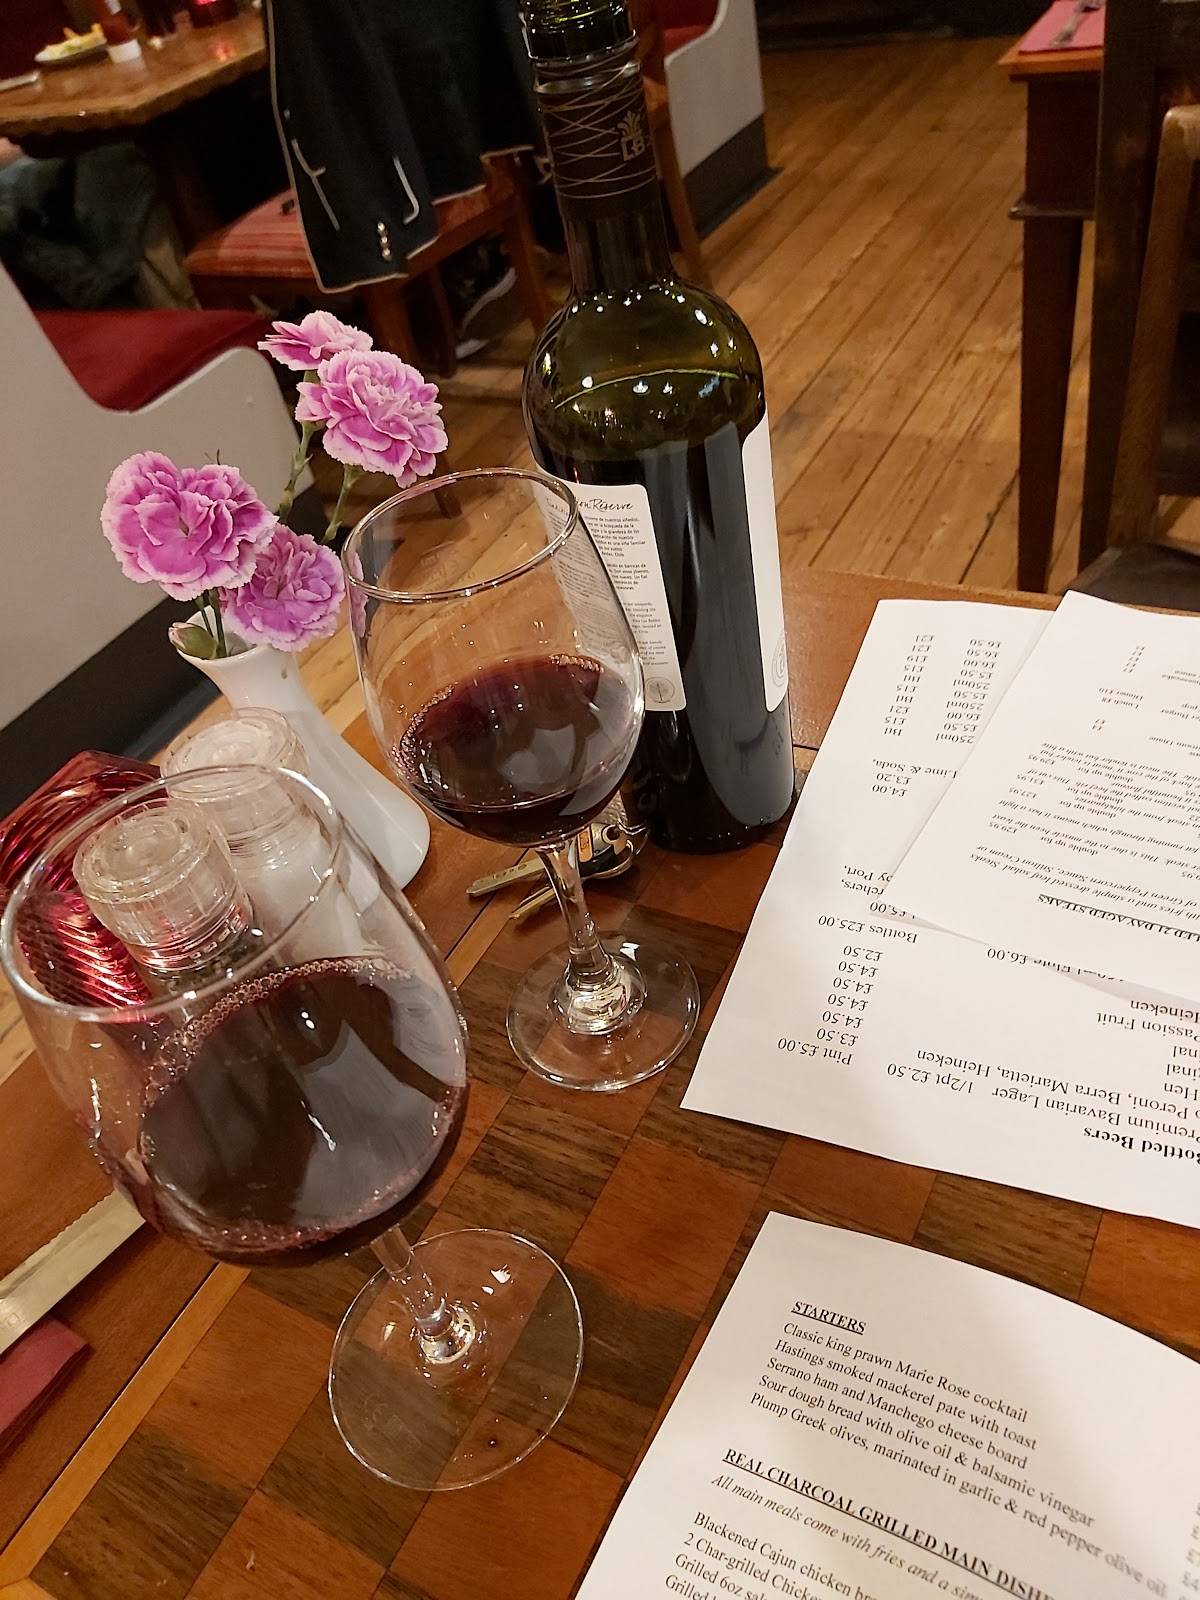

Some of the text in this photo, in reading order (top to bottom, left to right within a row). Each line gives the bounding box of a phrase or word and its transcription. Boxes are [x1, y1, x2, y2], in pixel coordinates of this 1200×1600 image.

[963, 659, 997, 669] £6.00
[960, 669, 993, 680] £5.50
[896, 684, 988, 700] £5.50 £15
[952, 679, 991, 691] 250ml
[889, 704, 982, 721] £6.00 £21
[945, 700, 985, 711] 250ml
[884, 716, 979, 733] £5.50 £15
[935, 732, 976, 744] 250ml
[876, 773, 912, 786] £3.20
[909, 765, 922, 775] &
[924, 767, 958, 780] Lime
[871, 785, 908, 798] £4.00
[840, 878, 886, 900] rchers,
[1036, 893, 1088, 914] STEAKS
[1088, 906, 1128, 924] AGED
[1126, 915, 1156, 931] DAY
[818, 914, 918, 944] Bottles £25.00
[1158, 924, 1173, 935] 21
[843, 945, 884, 962] £2.50
[987, 947, 1029, 965] £6.00
[838, 960, 879, 978] £4.50
[832, 976, 875, 995] £4.50
[827, 993, 869, 1012] £4.50
[1096, 1012, 1136, 1031] Fruit
[777, 1037, 820, 1057] £5.00
[822, 1010, 1199, 1102] Hen £4.50
[823, 1047, 853, 1066] Pint
[816, 1027, 1189, 1120] Peroni, Berra Marietta, Heineken £3.50
[887, 1063, 932, 1084] £2.50
[935, 1072, 973, 1094] 1/2pt
[991, 1087, 1040, 1109] Lager
[1045, 1098, 1121, 1126] Bavarian
[1083, 1127, 1134, 1150] Beers
[790, 1300, 867, 1336] STARTERS
[783, 1322, 1028, 1423] Classic king prawn Marie Rose cocktail
[774, 1338, 1037, 1451] Hastings smoked mackerel pate with toast
[766, 1356, 1028, 1470] Serrano ham and Manchego cheese board
[758, 1374, 1096, 1528] Sour dough bread with olive oil & balsamic vinegar
[749, 1392, 788, 1419] Plump
[790, 1408, 827, 1432] Greek
[829, 1424, 869, 1451] olives,
[873, 1443, 941, 1479] marinated
[942, 1467, 957, 1486] in
[958, 1480, 1002, 1506] garlic
[1003, 1498, 1018, 1514] &
[1022, 1509, 1048, 1529] red
[1049, 1523, 1103, 1558] pepper
[721, 1448, 765, 1479] REAL
[763, 1466, 856, 1518] CHARCOAL
[854, 1505, 937, 1555] GRILLED
[937, 1541, 992, 1582] MAIN
[710, 1474, 950, 1591] All main meals come with fries and a
[683, 1532, 771, 1583] 2 Char-grilled
[693, 1511, 852, 1597] Blackened Cajun chicken
[675, 1553, 744, 1597] Grilled 6oz
[665, 1574, 710, 1600] Grilled
